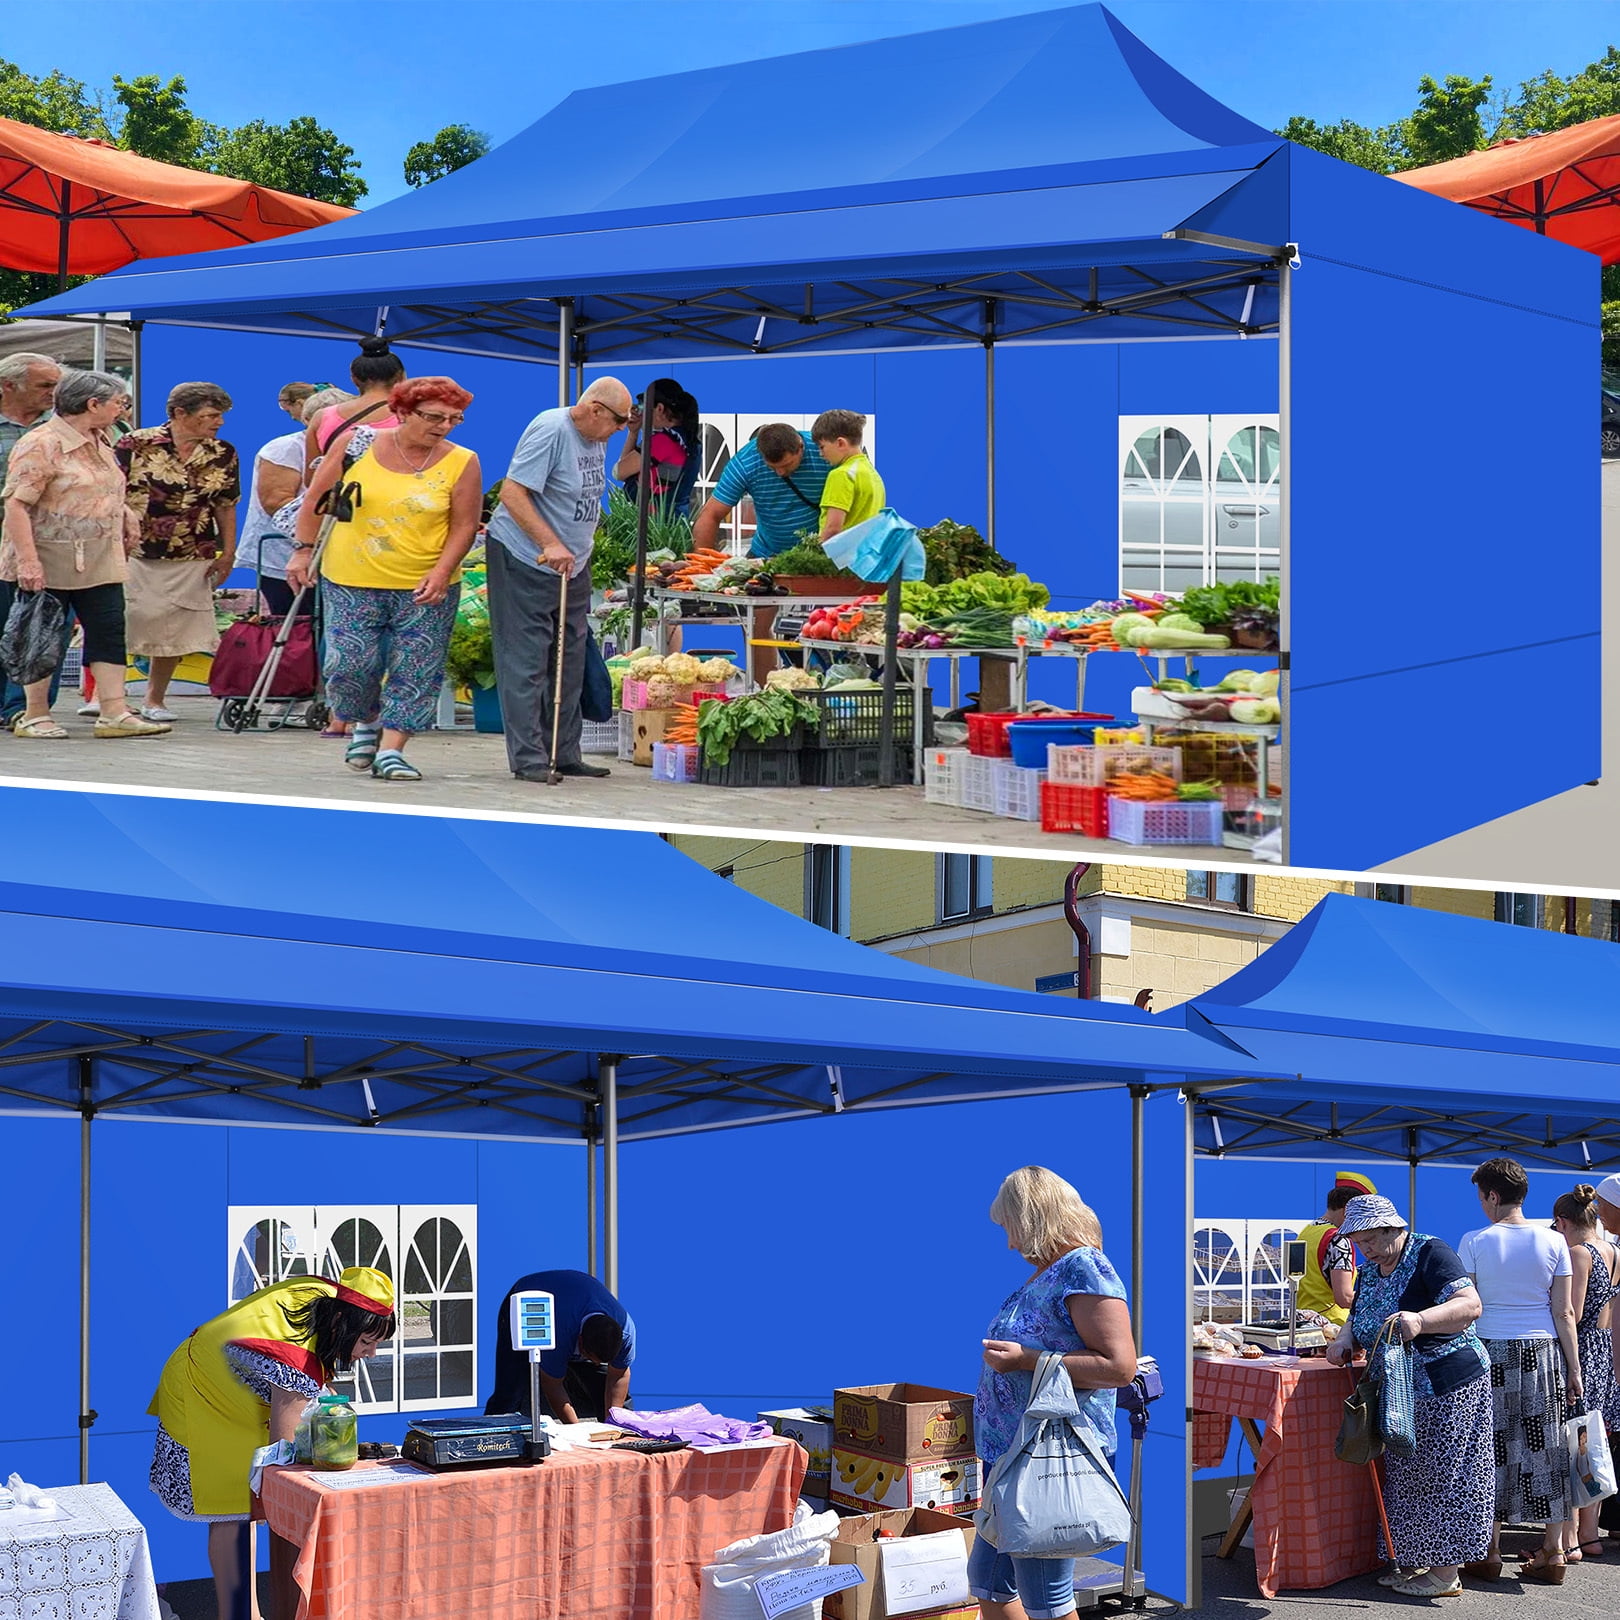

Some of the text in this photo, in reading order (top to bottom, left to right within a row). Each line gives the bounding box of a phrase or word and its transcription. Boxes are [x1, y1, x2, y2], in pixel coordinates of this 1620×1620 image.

[841, 1404, 869, 1420] PRIMA
[841, 1414, 870, 1431] DONNA
[933, 1422, 959, 1432] PRIMA
[932, 1430, 959, 1440] DONNA
[477, 1441, 511, 1453] Romitech
[930, 1580, 948, 1595] руб.
